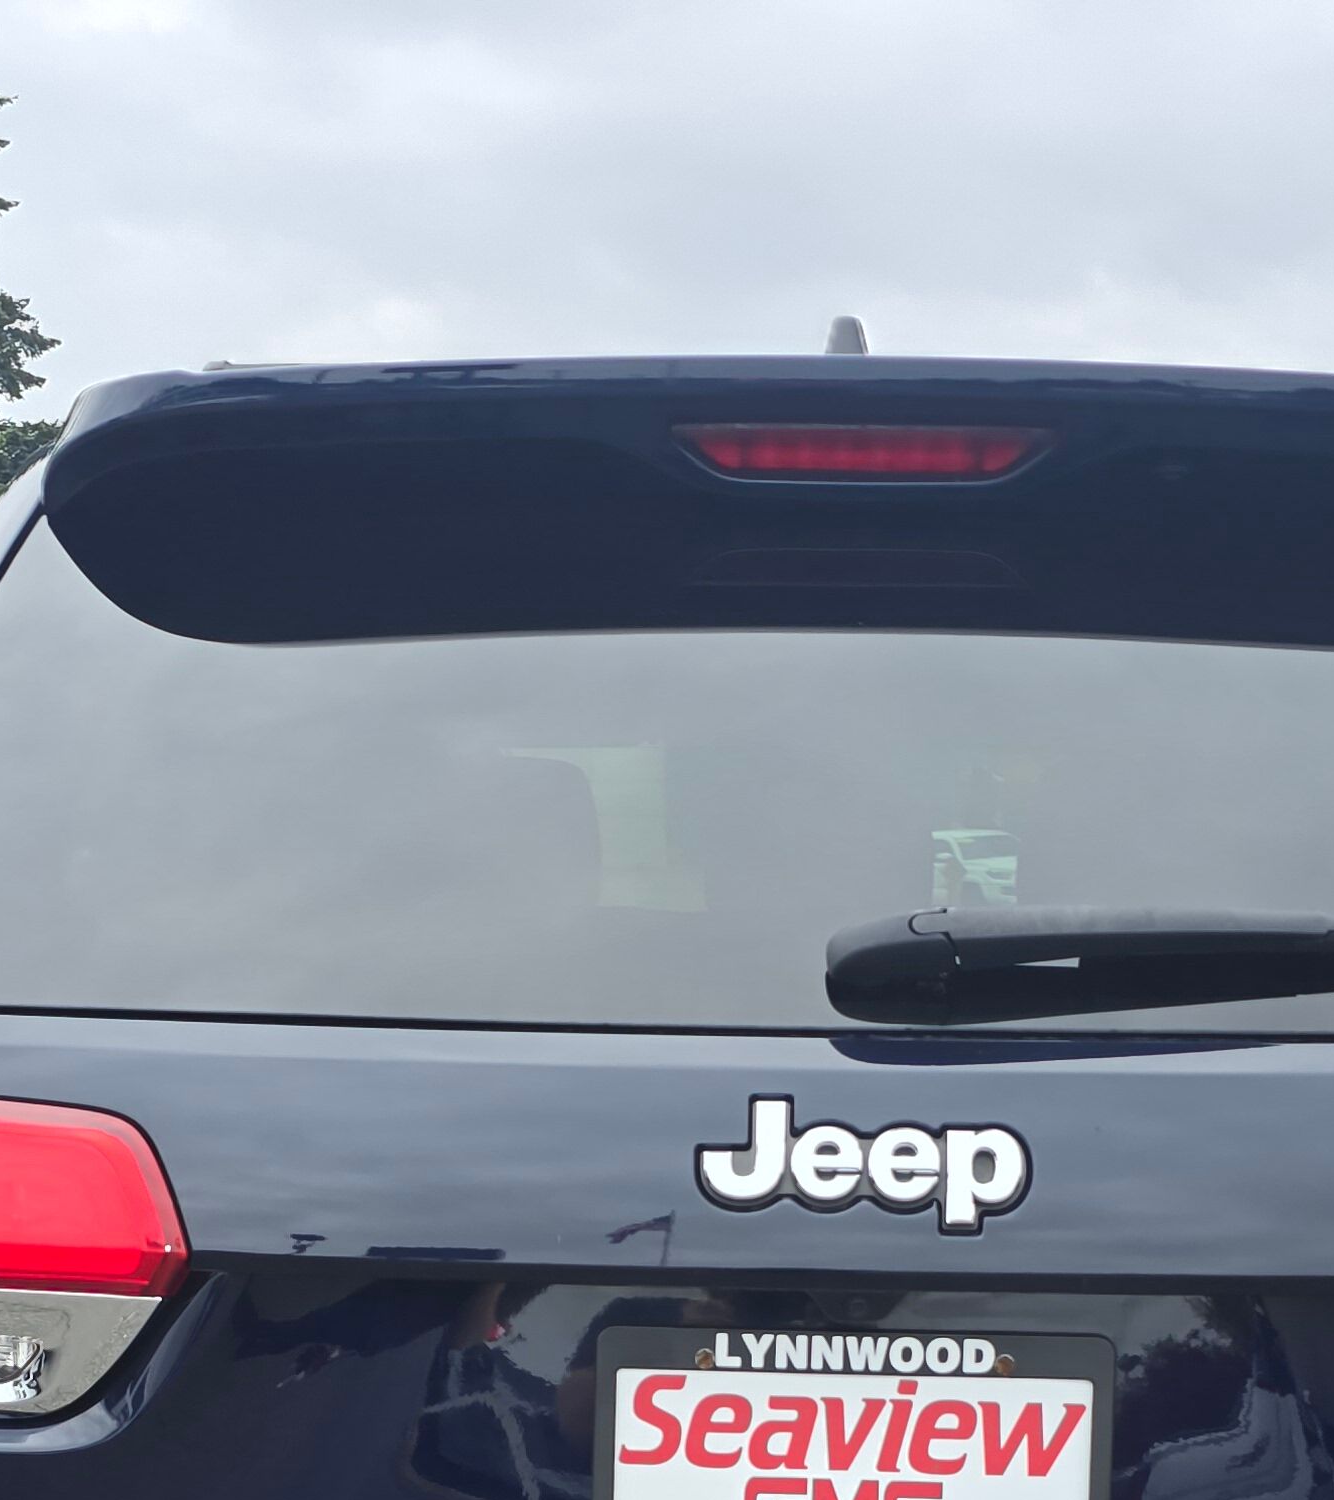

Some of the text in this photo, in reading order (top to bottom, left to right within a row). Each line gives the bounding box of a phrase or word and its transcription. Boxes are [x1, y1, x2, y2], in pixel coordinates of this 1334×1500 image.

[695, 1093, 1033, 1236] Jeep
[713, 1331, 996, 1375] LYNNWOOD
[619, 1374, 1087, 1477] Seaview
